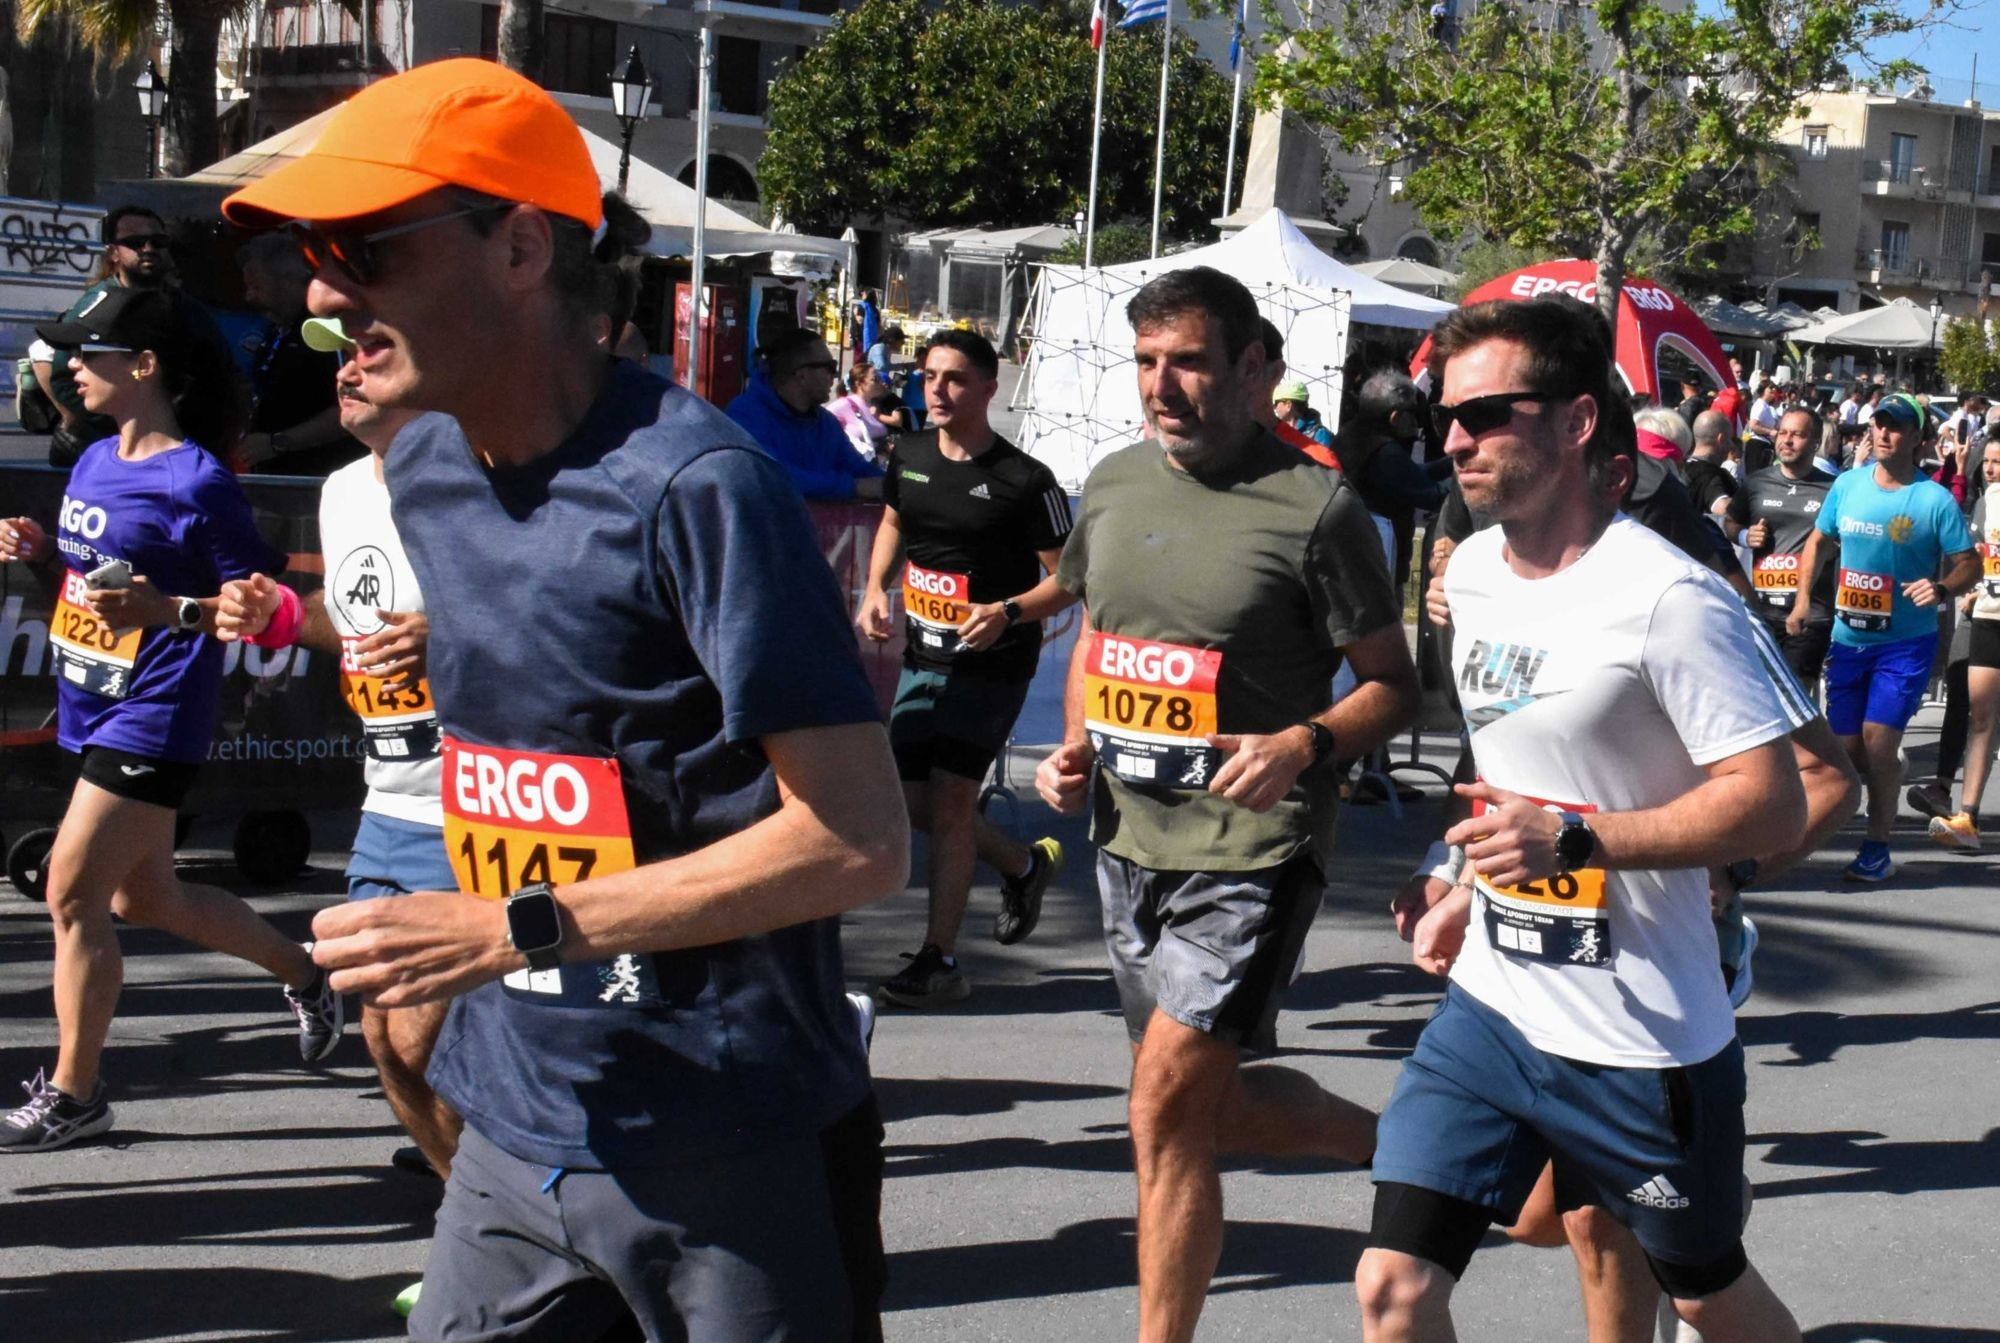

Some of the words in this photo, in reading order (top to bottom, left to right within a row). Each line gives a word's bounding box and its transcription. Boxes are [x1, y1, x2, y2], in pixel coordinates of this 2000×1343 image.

[1622, 285, 1674, 311] ERGO
[1762, 499, 1783, 507] ERGO
[908, 566, 956, 596] ERGO
[1758, 573, 1798, 587] 1046
[1845, 572, 1883, 591] ERGO
[910, 591, 957, 622] 1160
[1843, 591, 1883, 610] 1036
[1101, 638, 1194, 686] ERGO
[1460, 639, 1548, 698] RUN
[1098, 684, 1193, 731] 1078
[456, 750, 589, 826] ERGO
[460, 831, 597, 898] 1147
[1626, 1193, 1690, 1209] adidas
